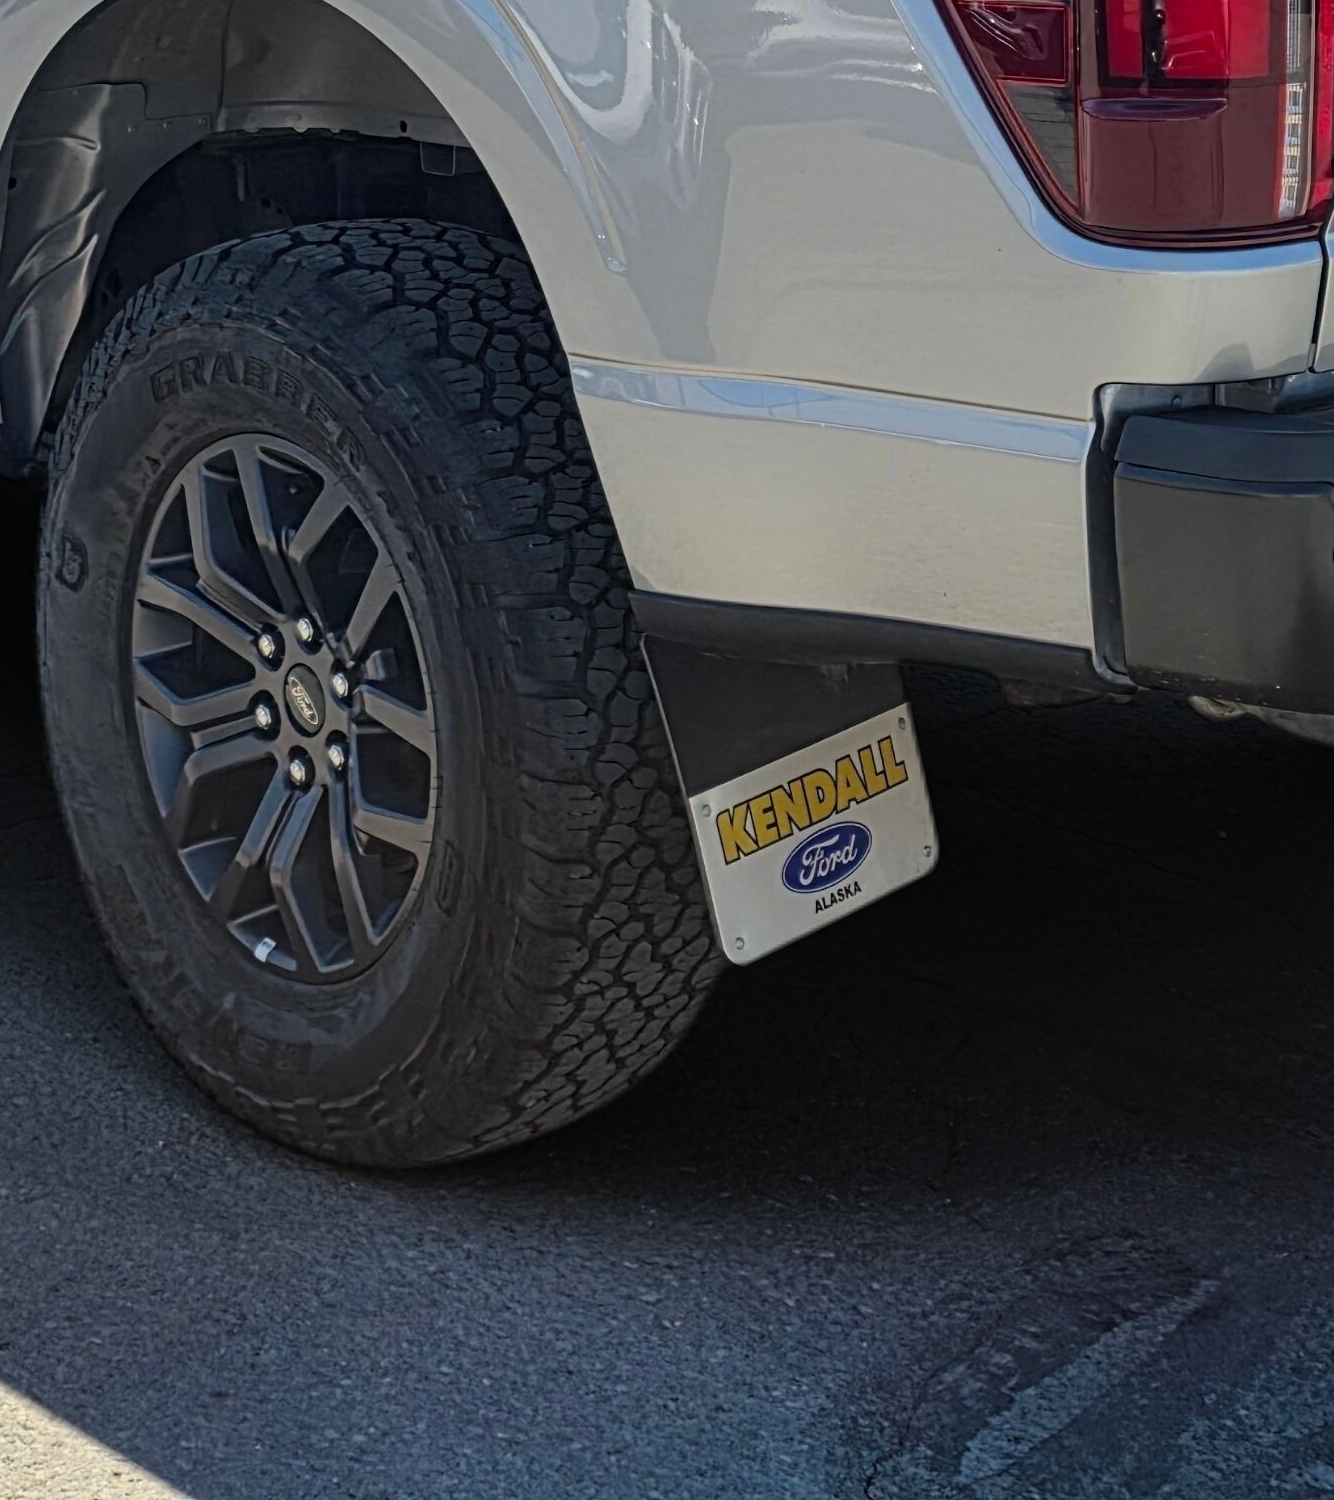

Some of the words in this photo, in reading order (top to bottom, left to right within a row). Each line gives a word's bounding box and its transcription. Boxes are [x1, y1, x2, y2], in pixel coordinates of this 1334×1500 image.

[716, 735, 908, 865] KENDALL
[798, 833, 859, 886] Ford
[814, 880, 863, 914] ALASKA
